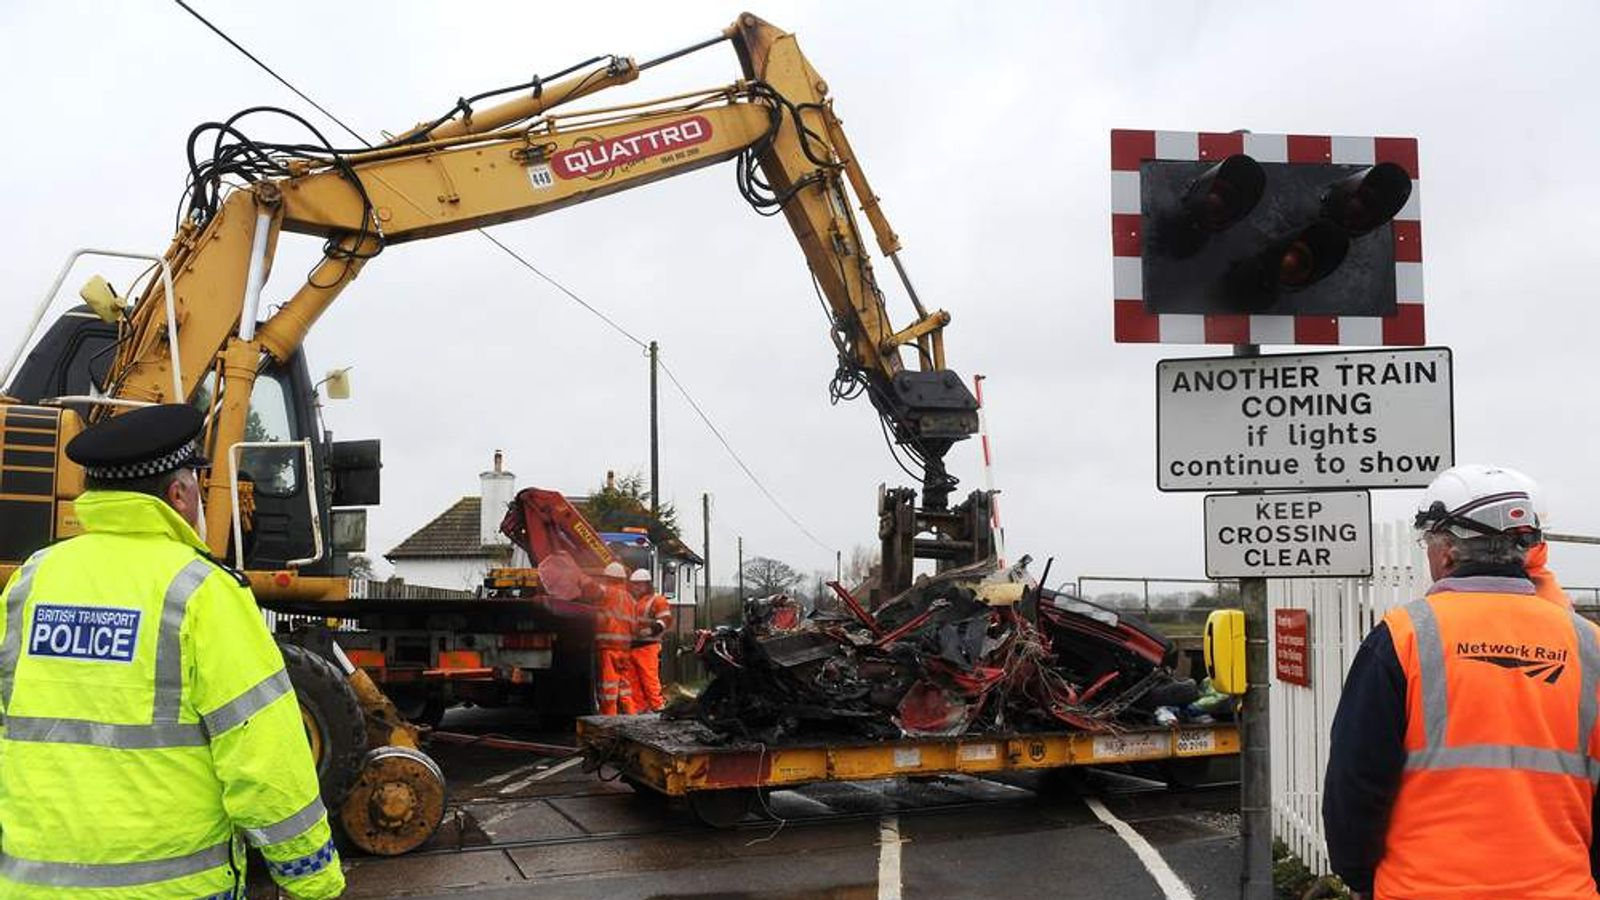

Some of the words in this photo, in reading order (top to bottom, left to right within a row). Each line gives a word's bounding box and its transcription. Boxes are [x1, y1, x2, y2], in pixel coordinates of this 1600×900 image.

[564, 120, 703, 173] QUATTRO
[1171, 366, 1319, 393] ANOTHER
[1336, 361, 1437, 385] TRAIN
[1241, 392, 1372, 418] COMING
[1247, 425, 1268, 447] if
[1288, 423, 1377, 450] lights
[1170, 454, 1299, 477] continue
[1315, 452, 1345, 474] to
[1360, 451, 1440, 473] show
[1256, 502, 1322, 520] KEEP
[1218, 523, 1357, 545] CROSSING
[1244, 549, 1331, 567] CLEAR
[37, 609, 76, 623] BRITISH
[78, 610, 136, 627] TRANSPORT
[32, 623, 133, 657] POLICE
[1457, 642, 1530, 658] Network
[1535, 647, 1568, 662] Rail
